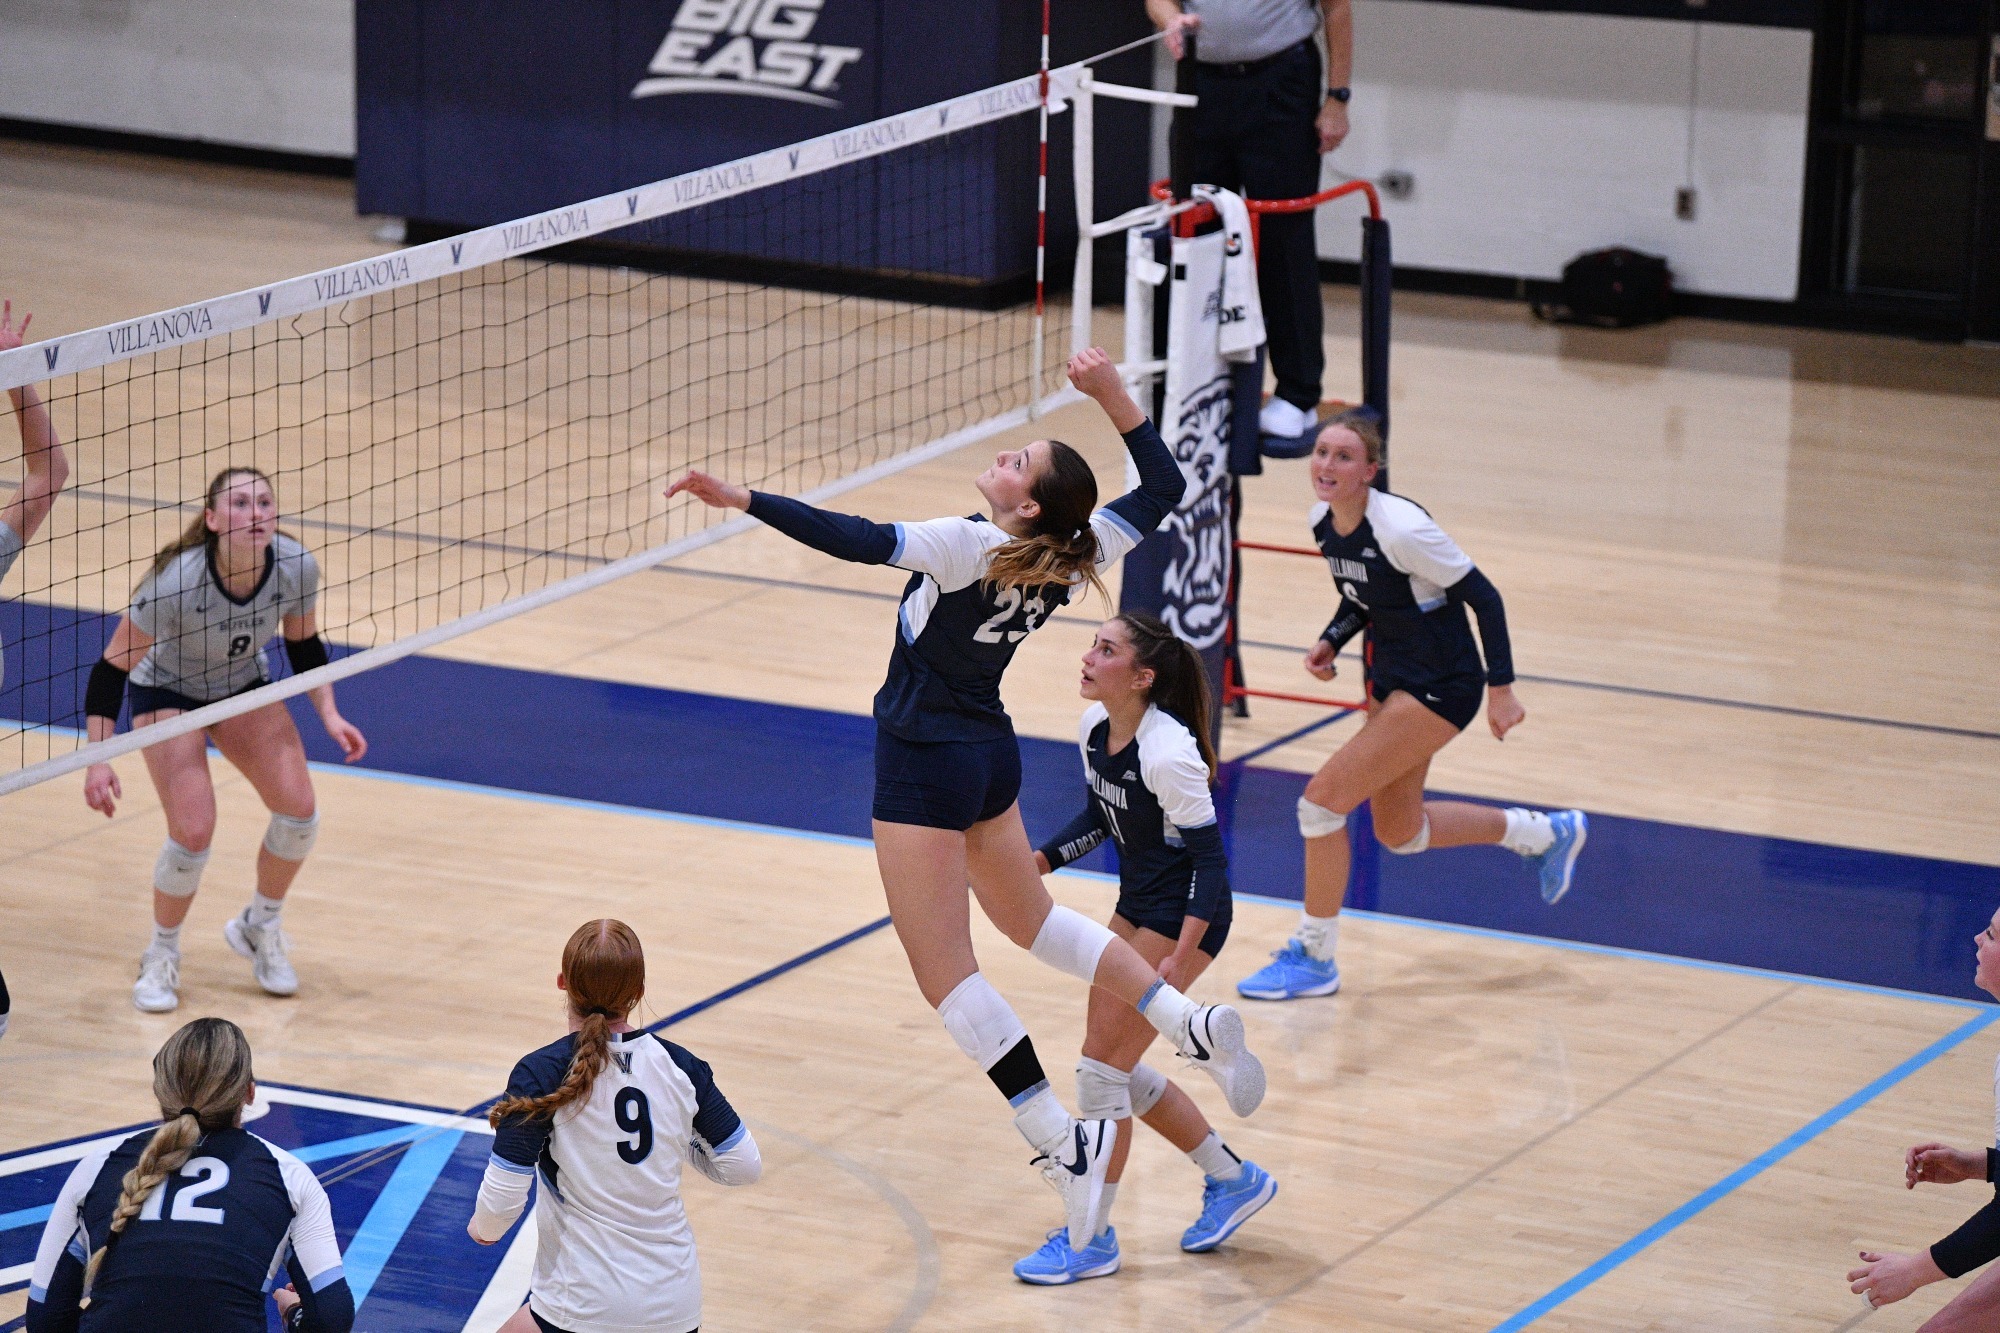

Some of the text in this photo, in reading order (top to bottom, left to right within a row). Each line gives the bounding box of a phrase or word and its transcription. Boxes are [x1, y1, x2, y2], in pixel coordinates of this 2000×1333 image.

[671, 0, 825, 40] BIG
[648, 30, 863, 90] EAST
[107, 307, 213, 355] VILLANOVA
[314, 256, 410, 301] VILLANOVA
[502, 208, 589, 252] VILLANOVA
[673, 162, 755, 203] VILLANOVA
[972, 587, 1045, 644] 23
[228, 635, 251, 657] 8
[1058, 828, 1107, 863] WILDCATS
[614, 1086, 655, 1165] 9
[139, 1156, 226, 1225] 12
